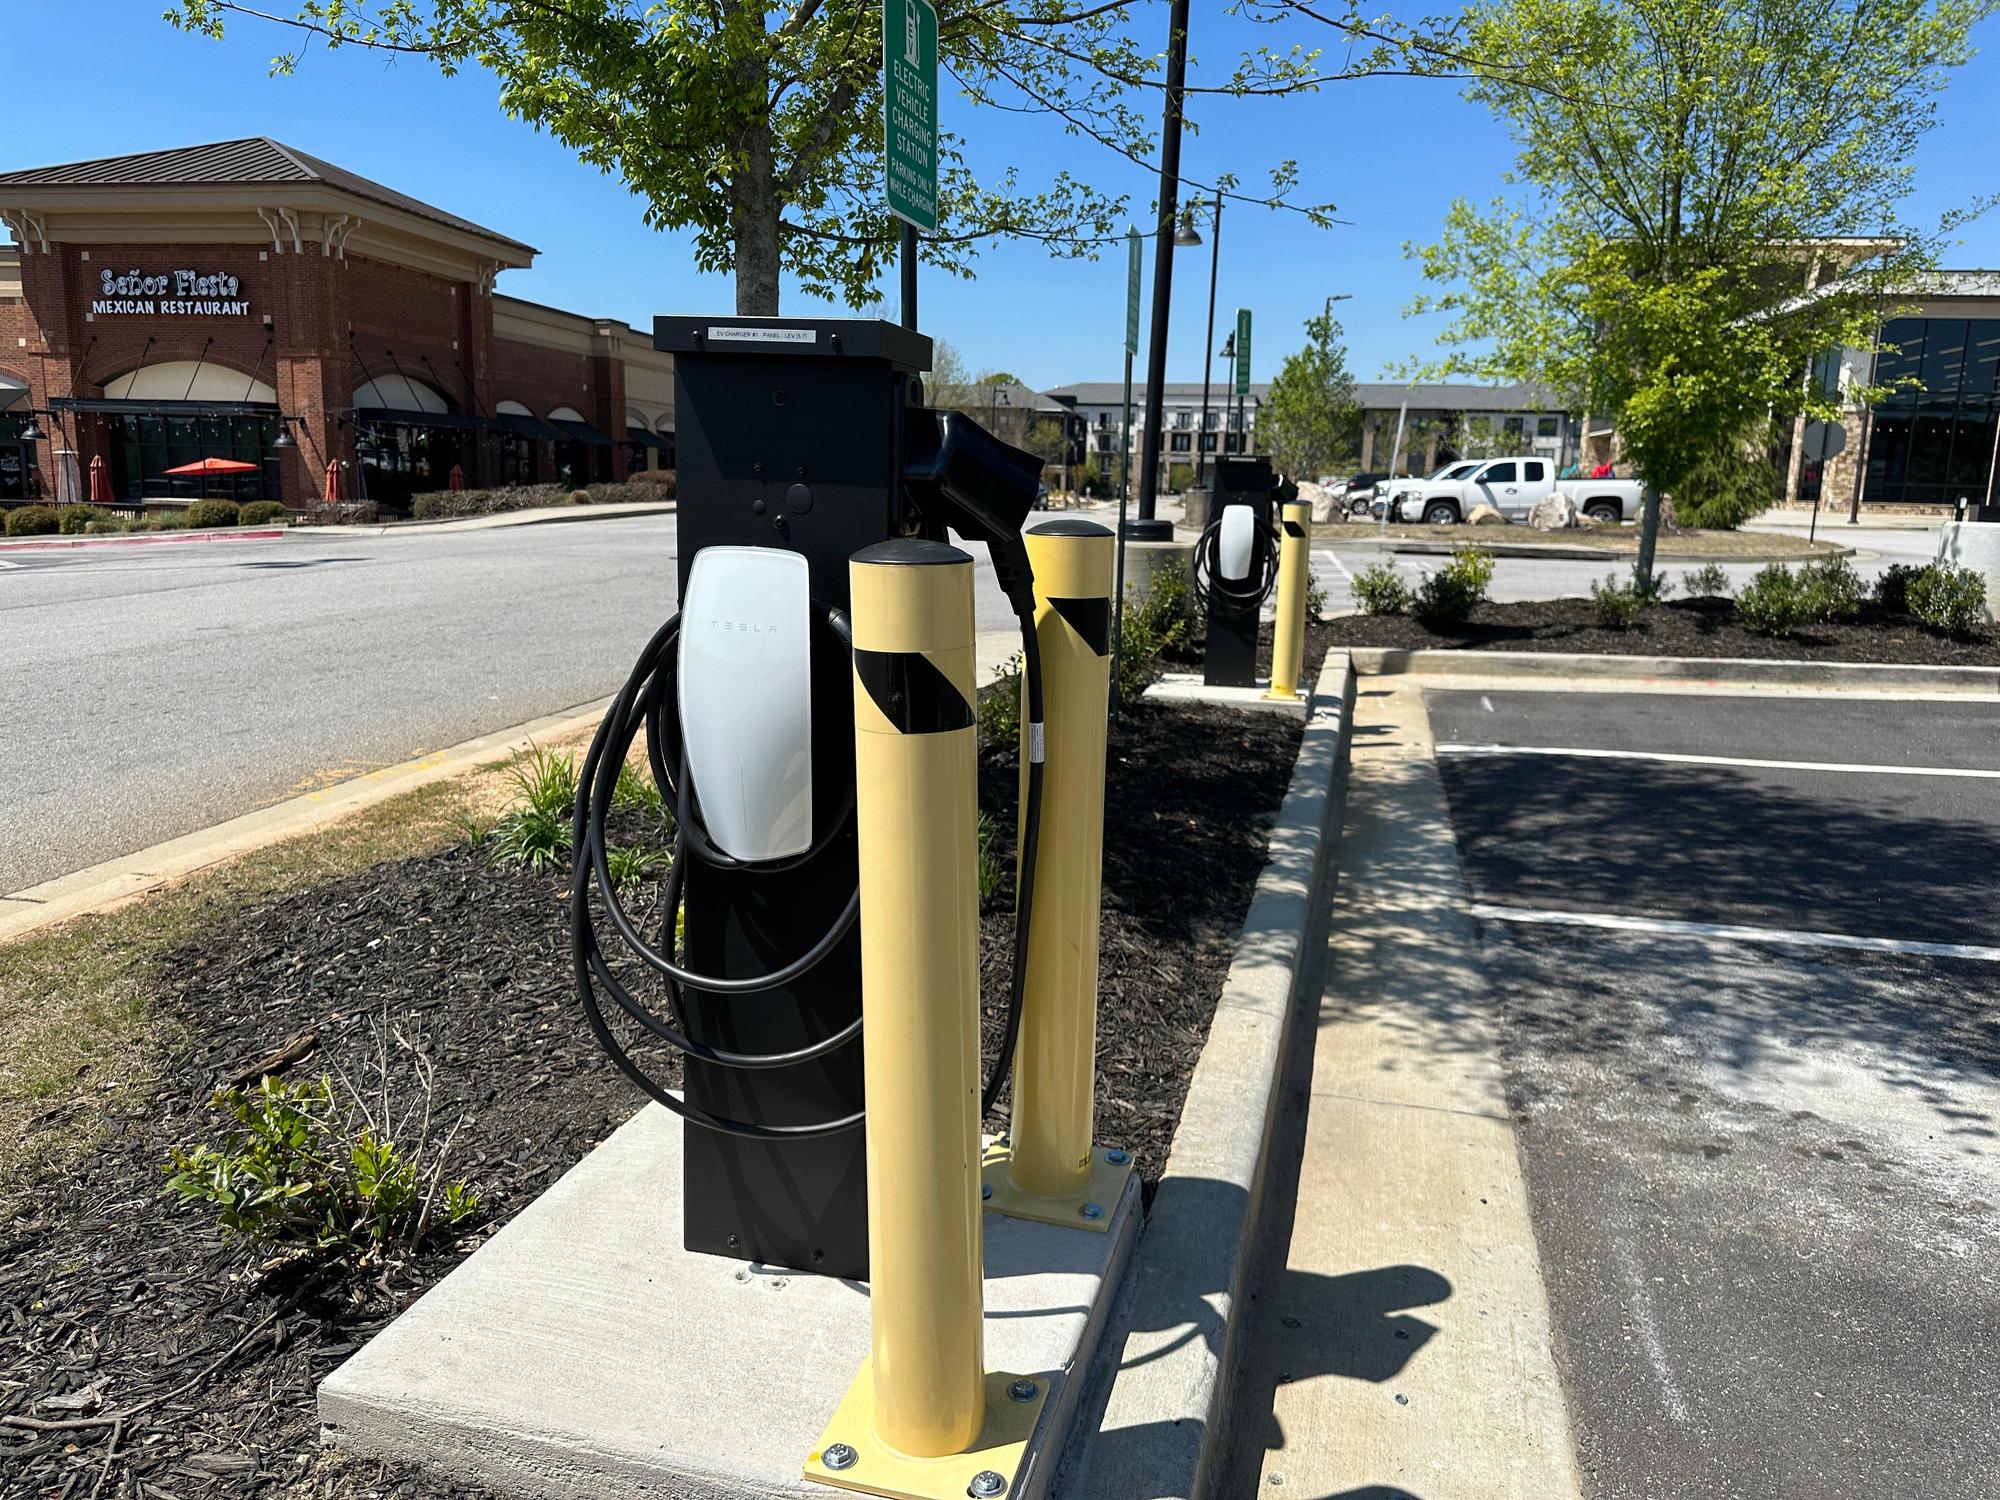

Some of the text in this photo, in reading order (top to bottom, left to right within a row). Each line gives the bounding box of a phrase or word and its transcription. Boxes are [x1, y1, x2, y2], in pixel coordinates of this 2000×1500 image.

[893, 59, 930, 102] ELECTRIC
[896, 84, 929, 124] VEHICLE
[892, 106, 932, 149] CHARGING
[896, 133, 928, 168] STATION
[891, 156, 933, 195] PARKING ONLY
[890, 176, 935, 216] WHILE CHARGING
[100, 268, 239, 297] Señor Fiesta
[92, 300, 250, 316] MEXICAN RESTAURANT
[710, 620, 777, 634] TESLA
